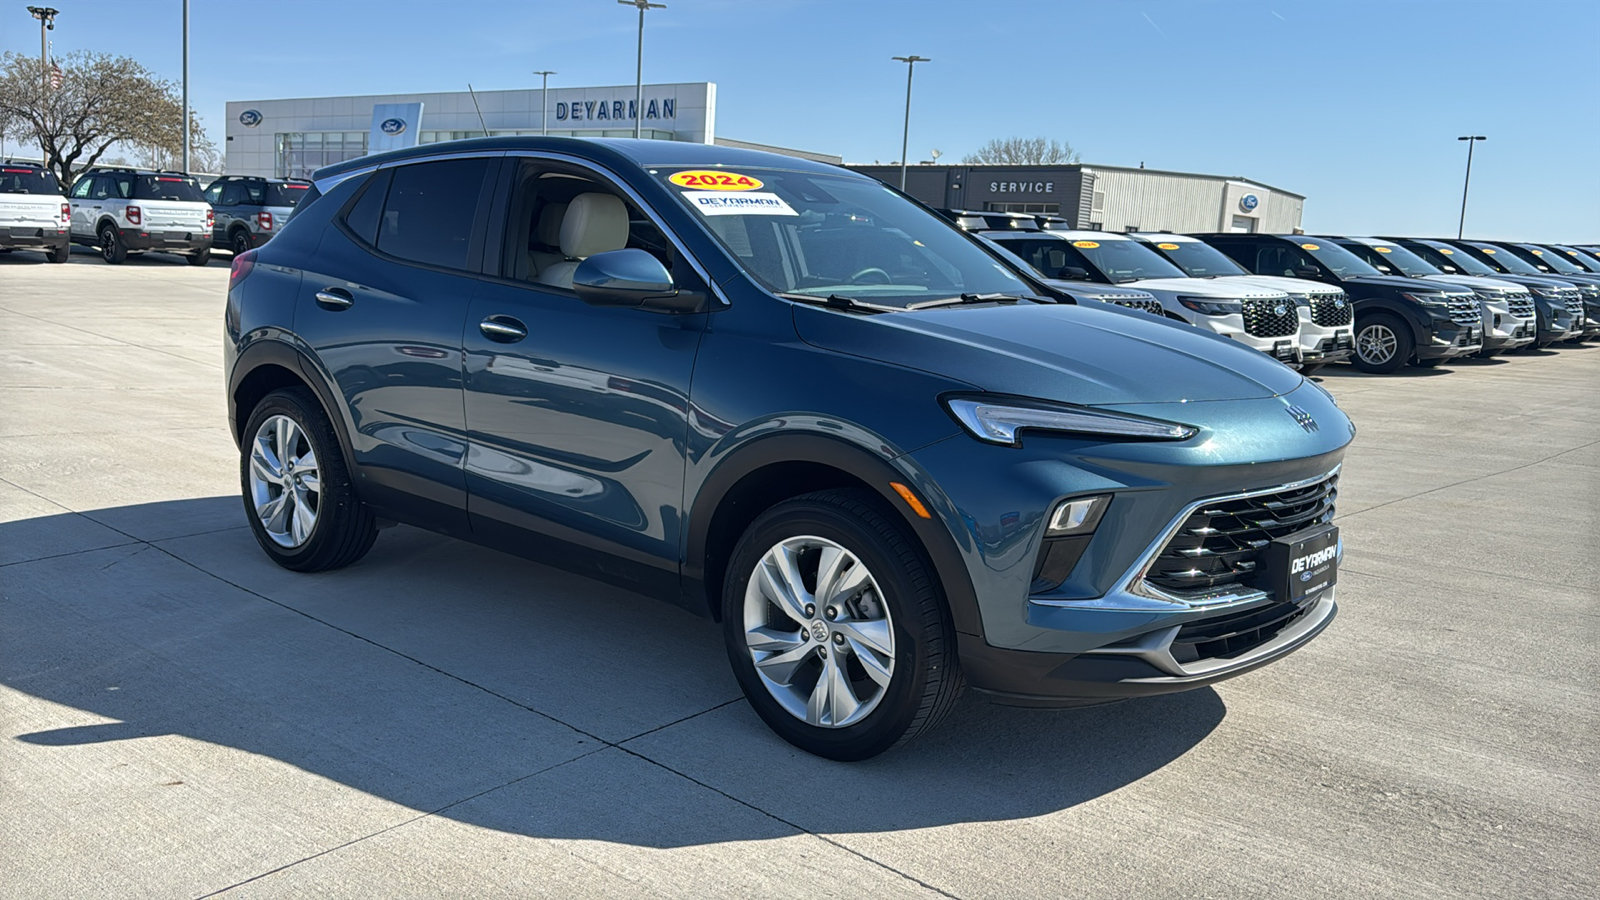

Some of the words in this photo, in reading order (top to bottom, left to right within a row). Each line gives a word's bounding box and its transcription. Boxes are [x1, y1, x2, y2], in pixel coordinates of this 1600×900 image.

[556, 98, 676, 121] DEYARMAN
[680, 175, 755, 187] 2024
[990, 181, 1054, 193] SERVICE
[697, 197, 780, 206] DEYARMAN
[1291, 545, 1337, 575] DEYARMAN
